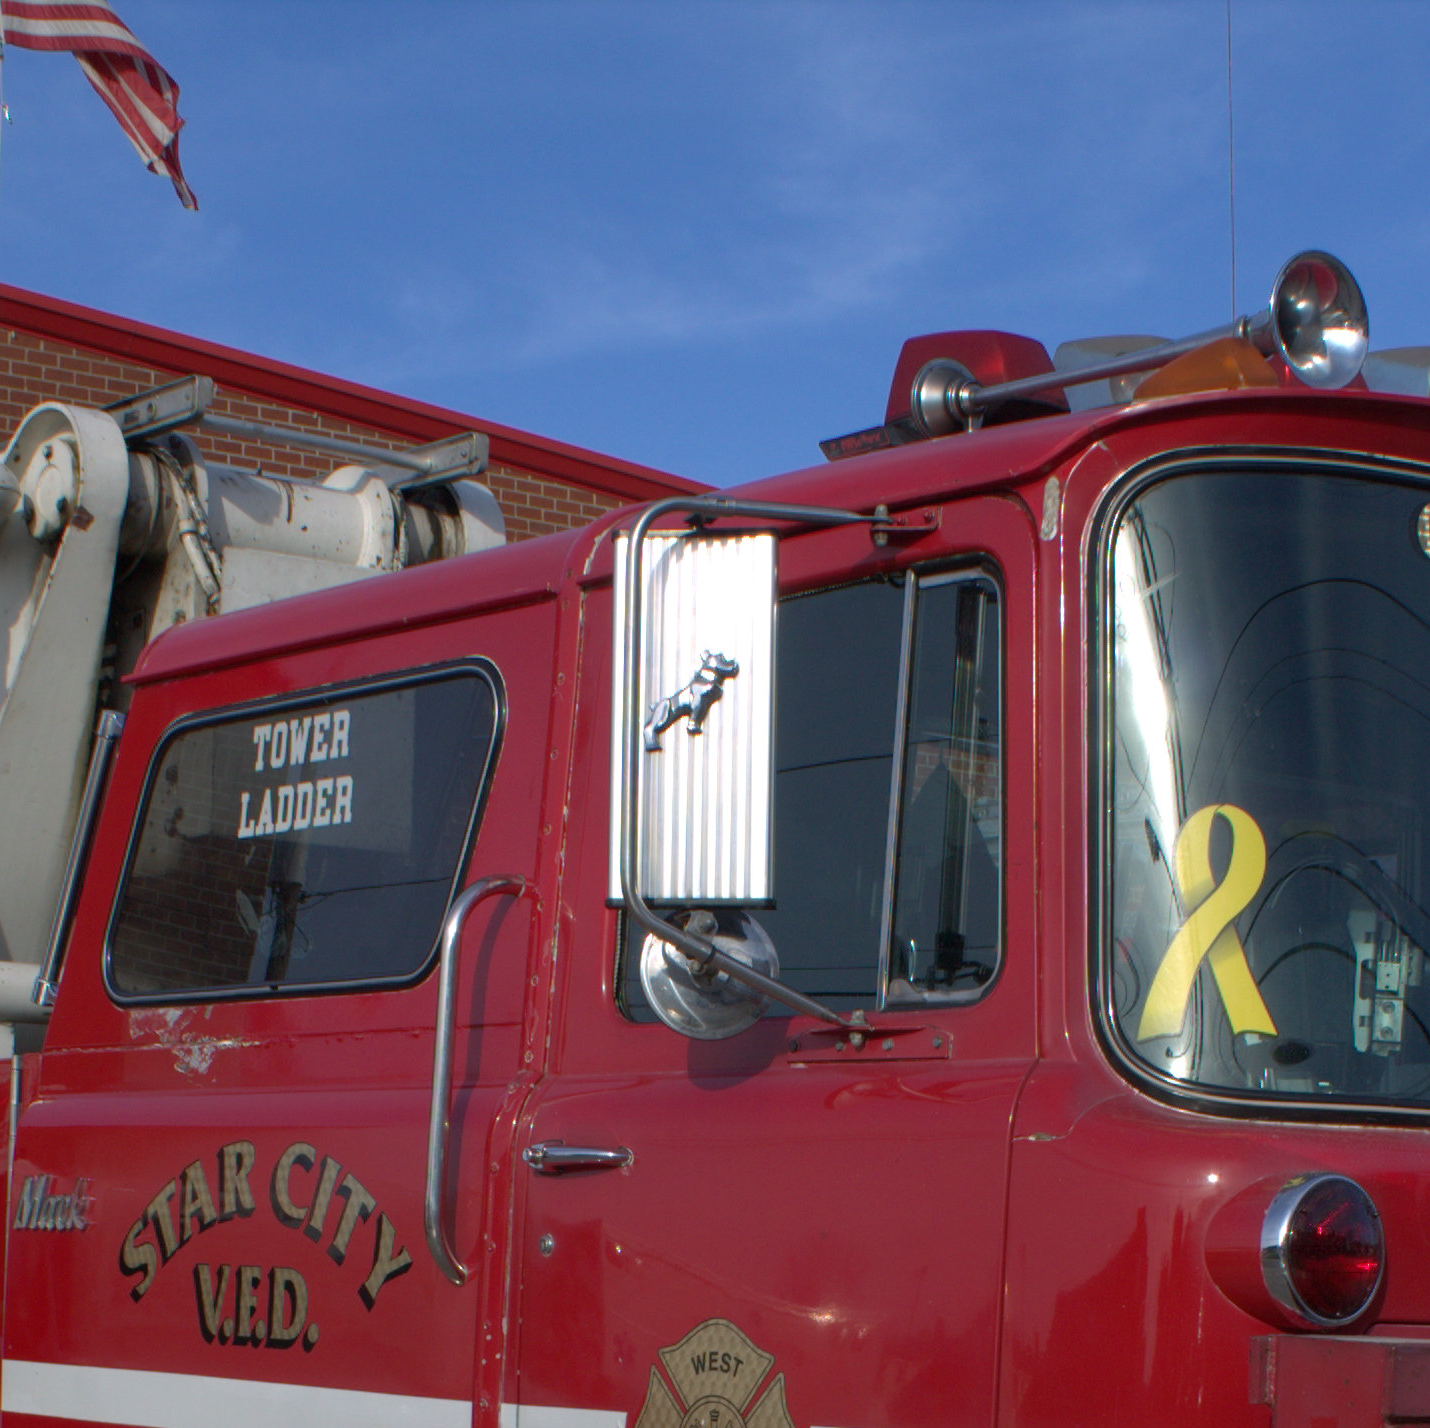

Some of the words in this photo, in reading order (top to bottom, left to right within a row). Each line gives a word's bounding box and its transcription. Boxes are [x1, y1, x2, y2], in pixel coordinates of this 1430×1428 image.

[253, 709, 351, 772] TOWER
[237, 775, 353, 839] LADDER
[118, 1140, 255, 1302] STAR
[271, 1141, 413, 1310] CITY
[193, 1263, 319, 1351] V.F.D.
[691, 1351, 744, 1378] WEST
